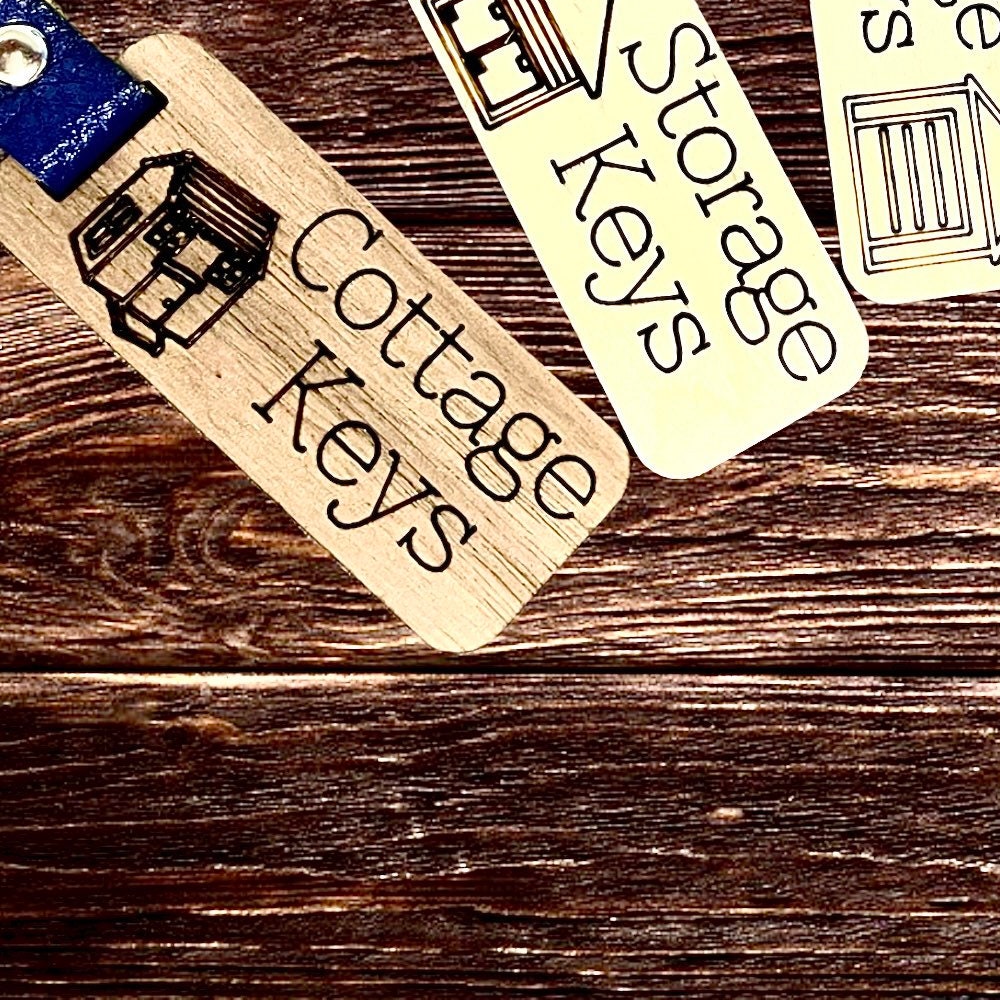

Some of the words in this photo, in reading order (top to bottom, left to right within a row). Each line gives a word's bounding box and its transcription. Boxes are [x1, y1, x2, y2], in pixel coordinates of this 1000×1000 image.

[550, 122, 711, 377] Keys
[621, 21, 838, 382] Storage
[251, 338, 479, 575] Keys
[290, 207, 598, 522] Cottage
